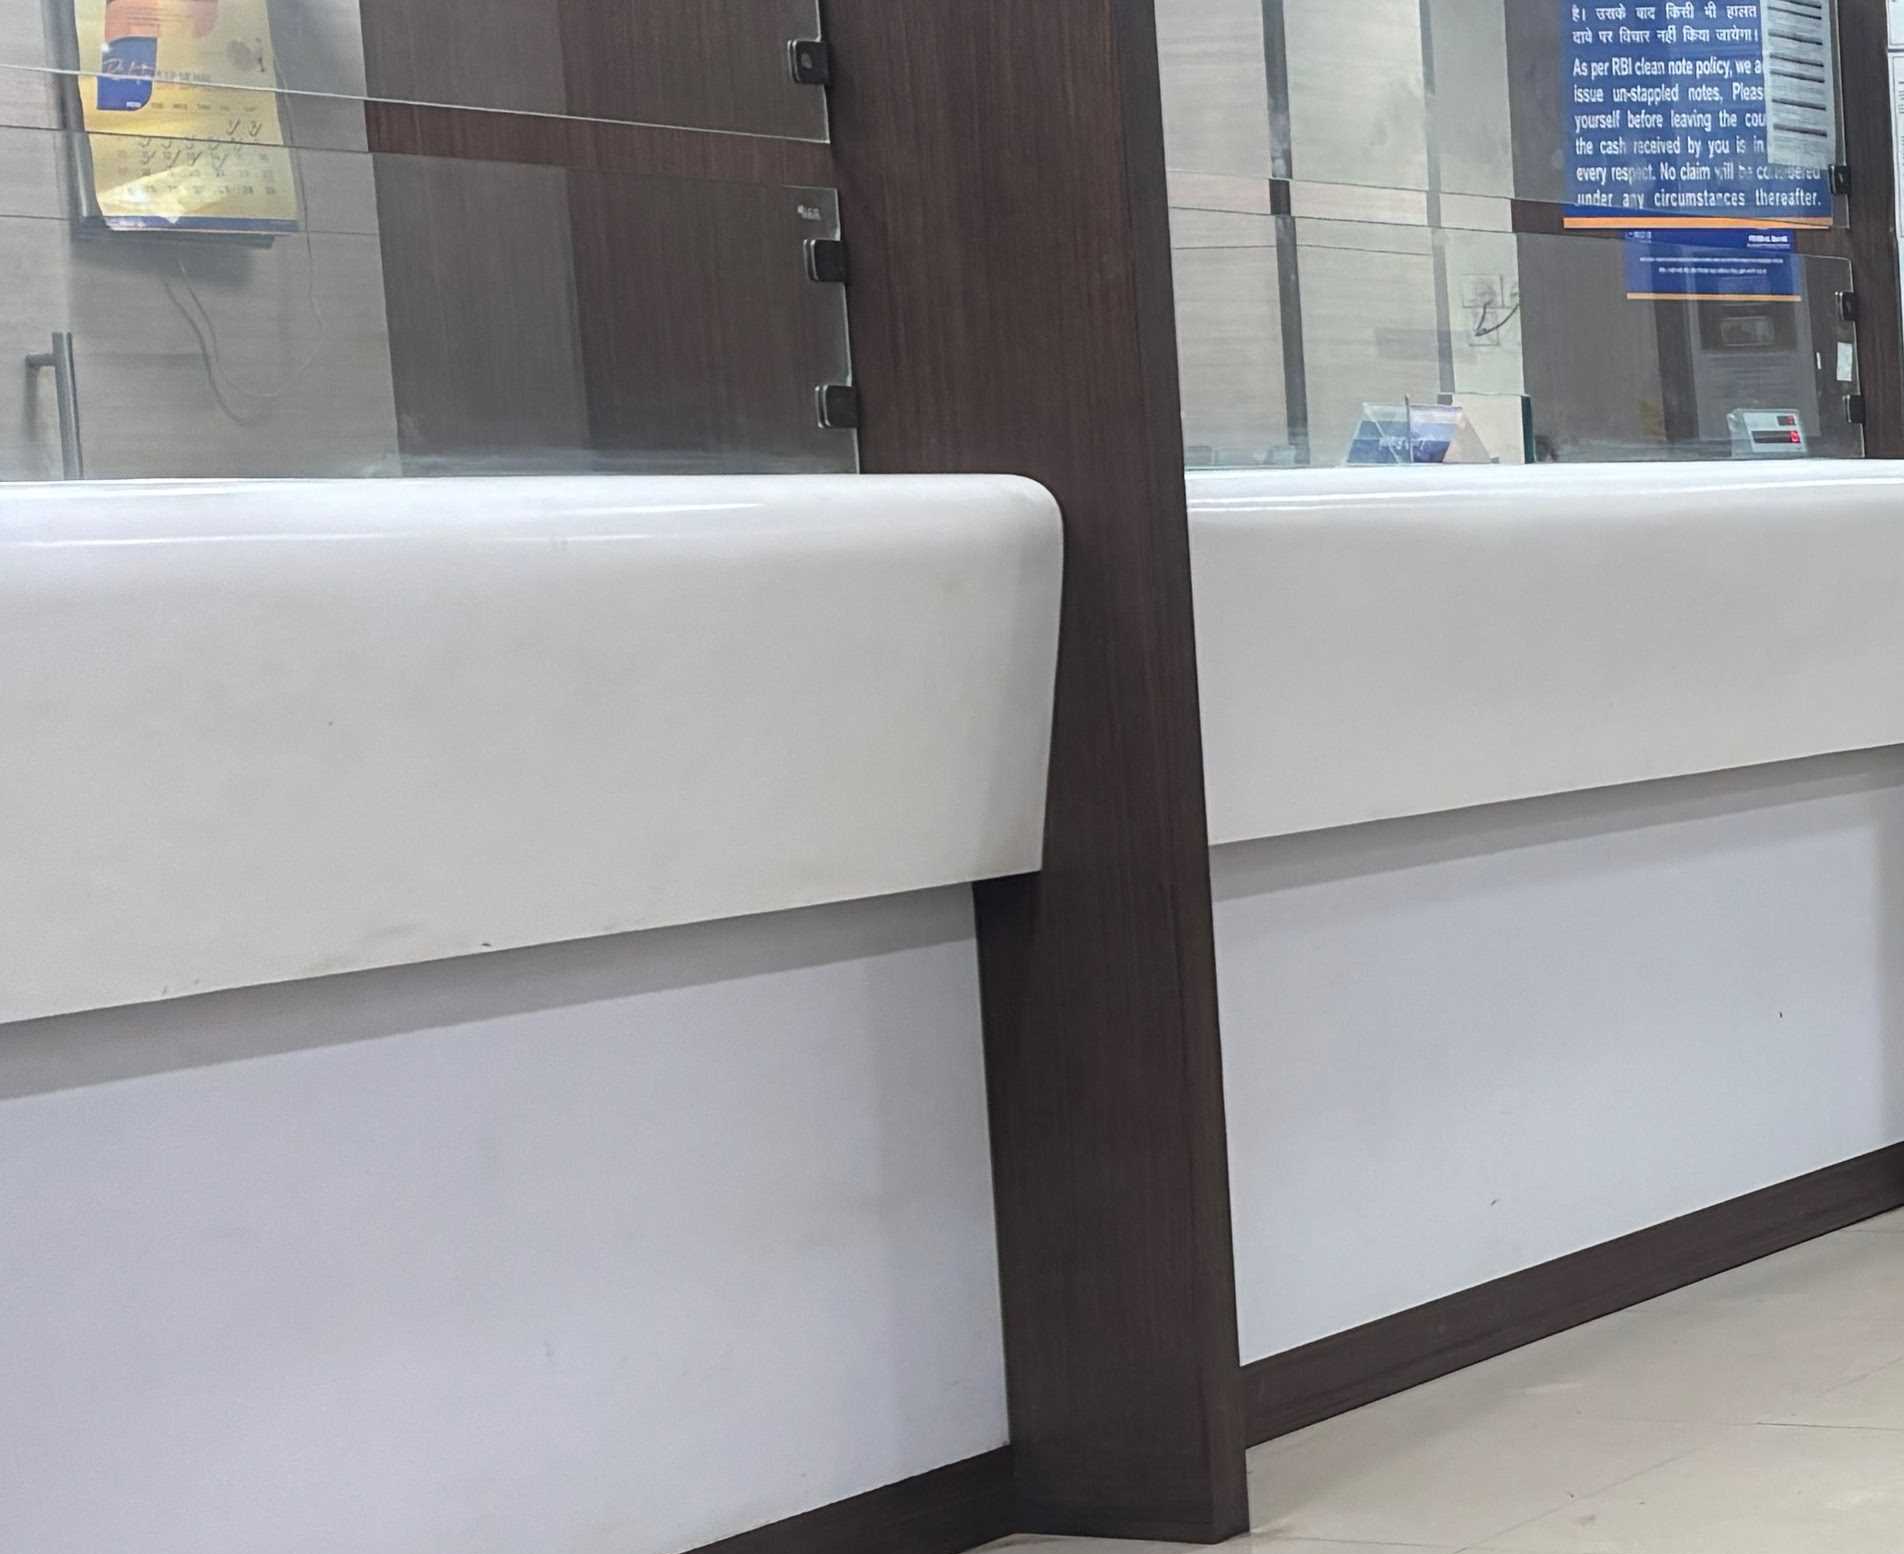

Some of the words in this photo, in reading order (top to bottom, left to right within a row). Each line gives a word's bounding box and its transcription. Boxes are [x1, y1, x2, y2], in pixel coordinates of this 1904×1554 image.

[1595, 4, 1626, 20] उसके
[1636, 6, 1656, 20] बाद
[1666, 2, 1694, 19] किसी
[1704, 1, 1717, 18] भी
[1726, 5, 1757, 19] हालत
[1572, 27, 1593, 43] दावे
[1599, 30, 1613, 43] पर
[1619, 26, 1650, 43] विचार
[1656, 25, 1676, 44] नहीं
[1682, 26, 1710, 42] किया
[1573, 58, 1588, 77] As
[1591, 61, 1608, 80] per
[1612, 58, 1633, 75] RBI
[1635, 58, 1665, 75] clean
[1668, 57, 1693, 74] note
[1695, 57, 1733, 79] policy,
[1736, 60, 1753, 74] we
[1573, 85, 1604, 102] issue
[1613, 83, 1679, 105] un-stappled
[1732, 82, 1764, 101] Pleas
[1574, 110, 1620, 133] yourself
[1627, 111, 1663, 128] before
[1671, 110, 1712, 132] leaving
[1719, 110, 1737, 126] the
[1575, 137, 1593, 155] the
[1600, 137, 1627, 155] cash
[1633, 136, 1680, 154] received
[1687, 136, 1702, 158] by
[1707, 140, 1730, 158] you
[1736, 136, 1746, 154] is
[1753, 136, 1764, 153] in
[1576, 165, 1607, 185] every
[1660, 162, 1676, 180] No
[1680, 162, 1710, 180] claim
[1757, 163, 1821, 180] codered
[1577, 190, 1613, 207] under
[1623, 193, 1644, 209] any
[1654, 189, 1745, 207] circumstances
[1755, 189, 1821, 207] thereafter.
